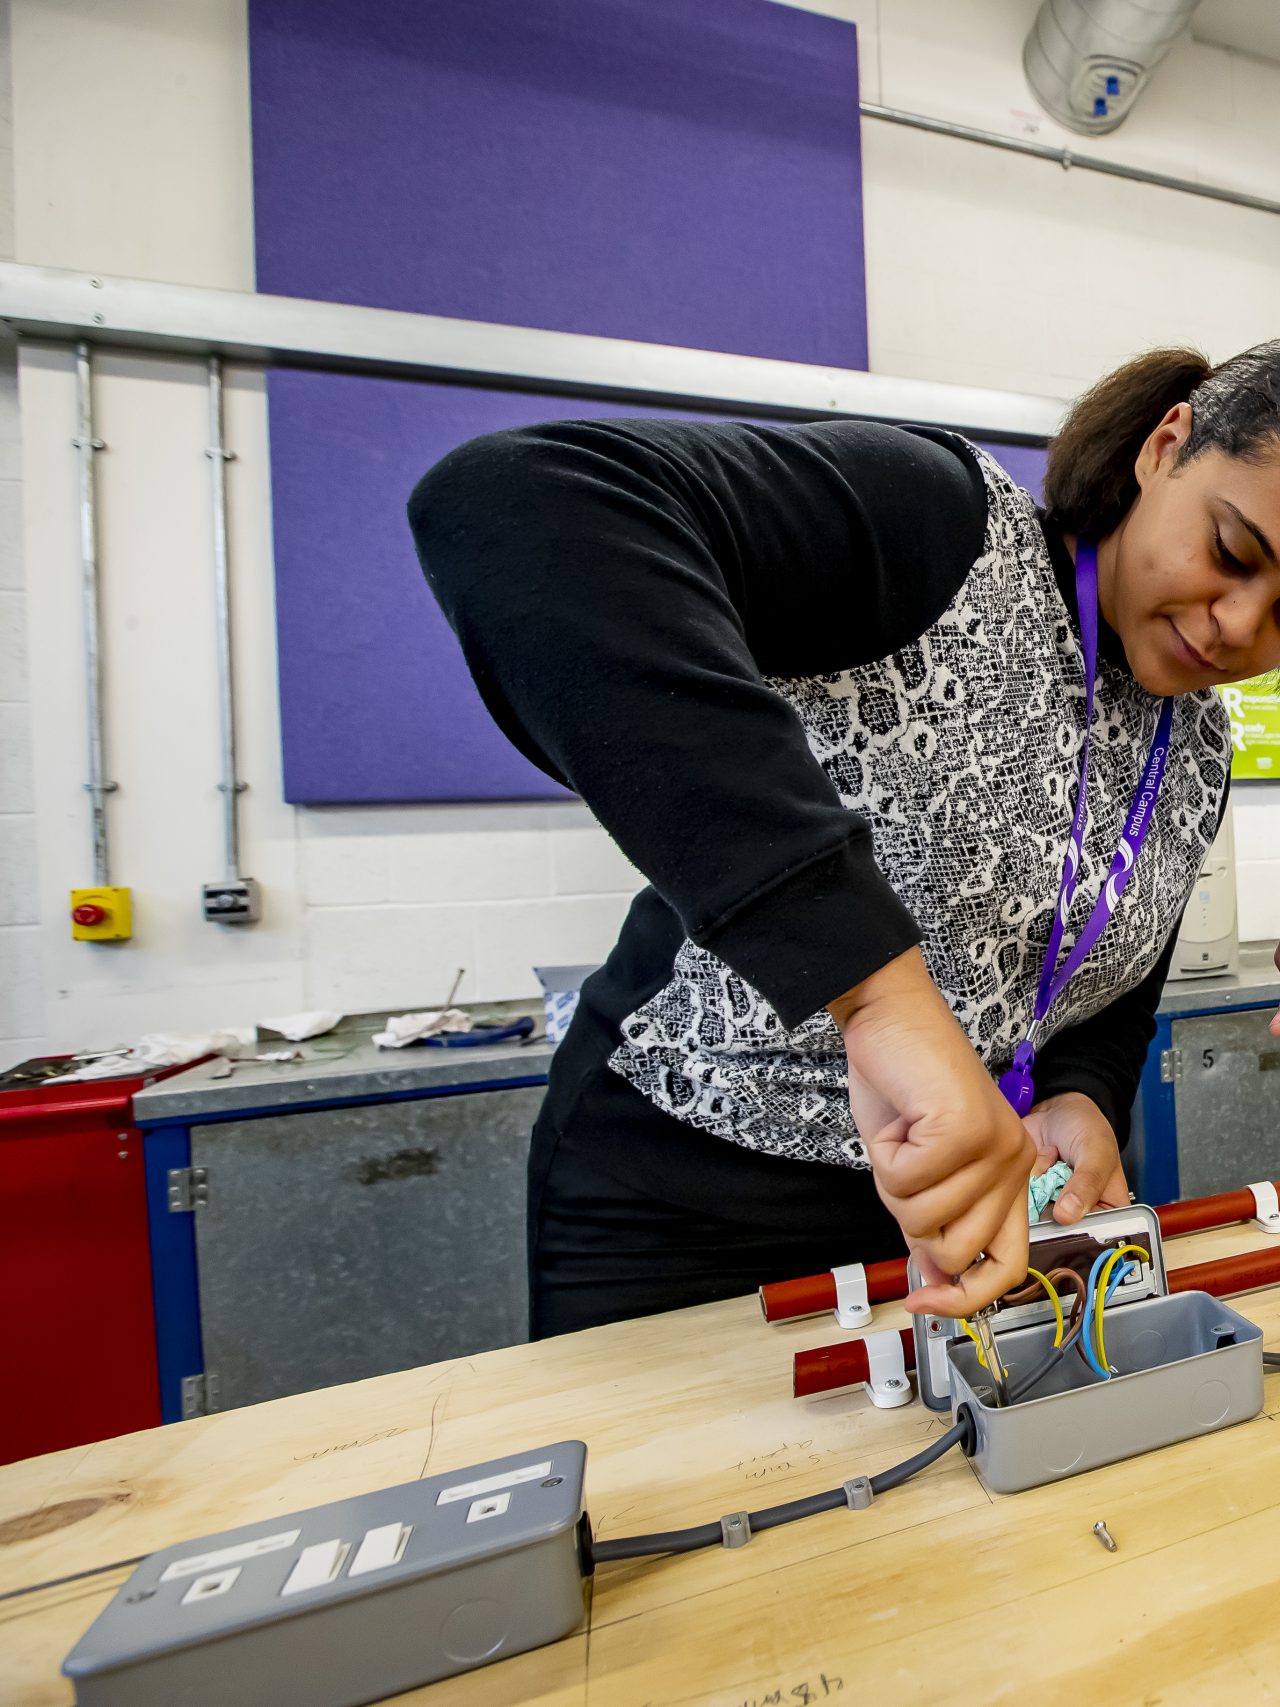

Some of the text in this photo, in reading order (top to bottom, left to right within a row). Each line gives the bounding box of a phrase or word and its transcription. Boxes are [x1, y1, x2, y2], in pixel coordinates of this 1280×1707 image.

[1129, 746, 1165, 837] Central Campus
[1203, 1049, 1214, 1068] 5
